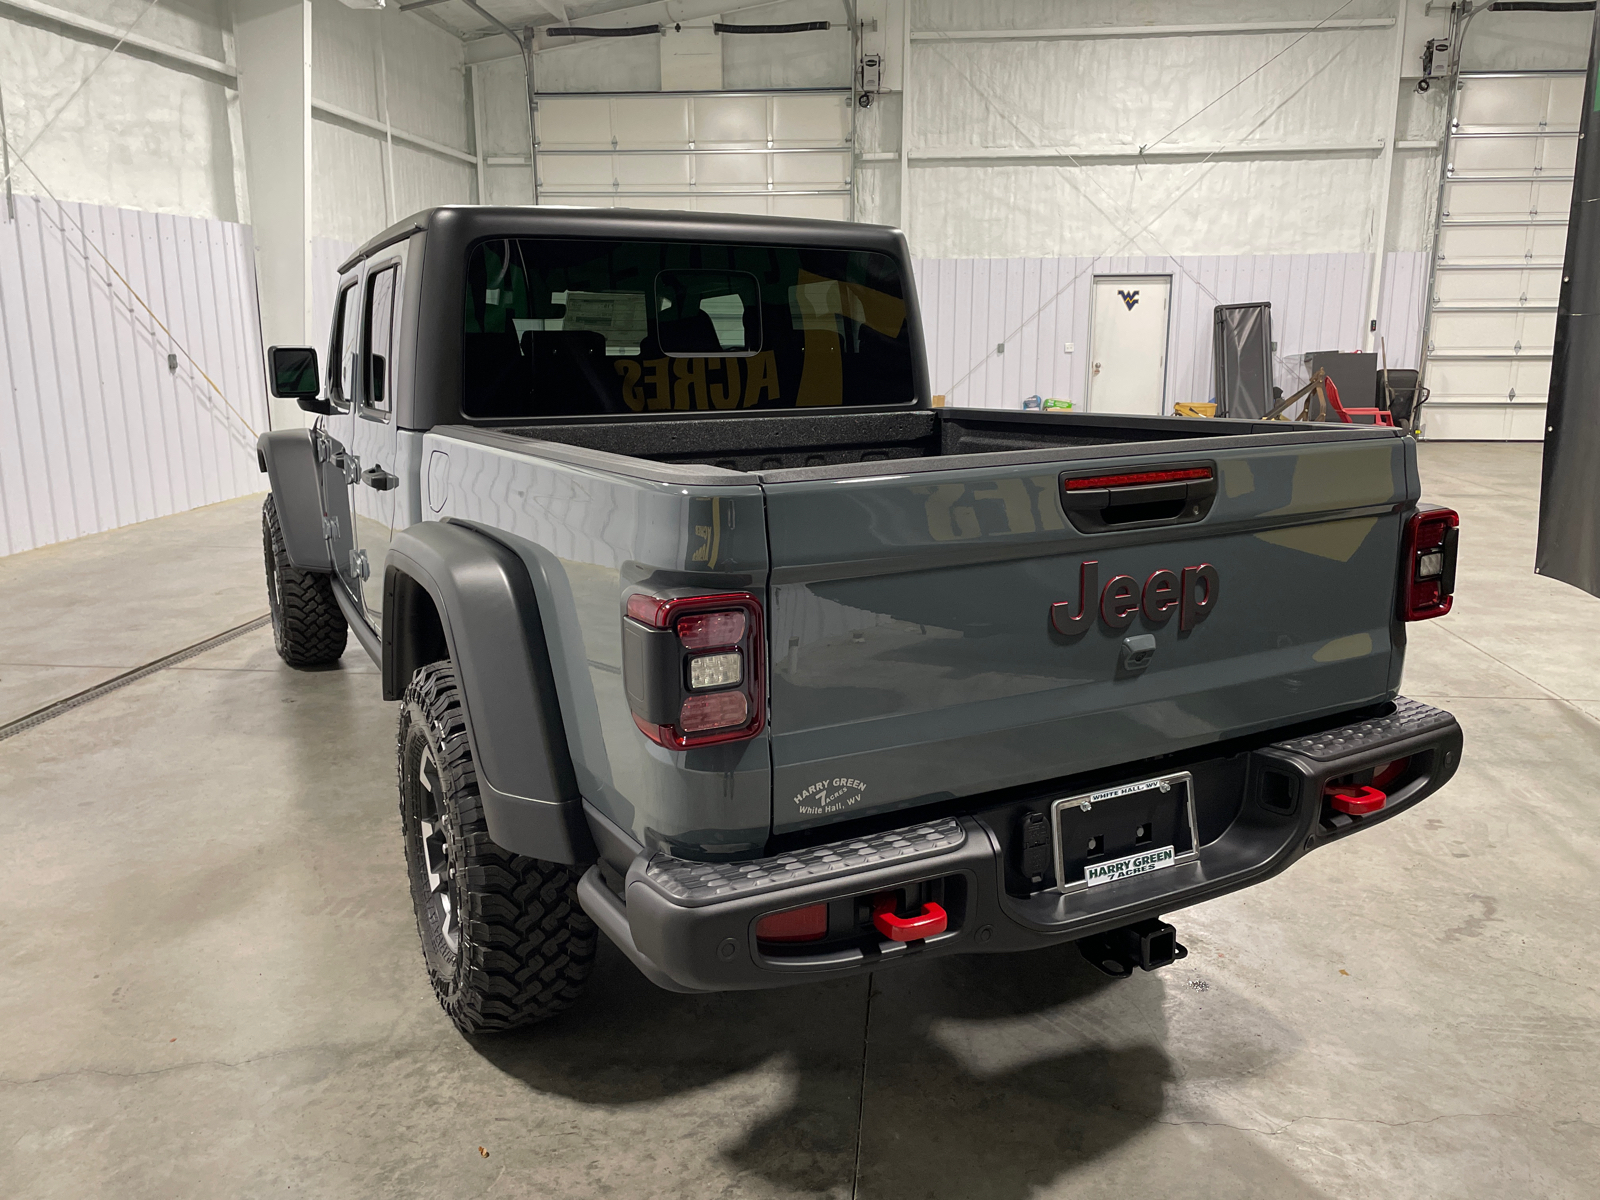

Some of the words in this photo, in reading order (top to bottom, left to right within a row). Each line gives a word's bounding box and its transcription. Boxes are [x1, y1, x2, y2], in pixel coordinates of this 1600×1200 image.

[1051, 560, 1220, 636] Jeep
[793, 779, 830, 804] HARRY
[832, 777, 867, 792] GREEN
[815, 790, 827, 807] 7
[825, 786, 848, 804] ACRES
[1092, 791, 1119, 801] WHITE
[799, 805, 823, 814] White
[825, 802, 845, 813] Hall,
[846, 793, 861, 806] WV
[1088, 860, 1131, 879] HARRY
[1133, 849, 1172, 867] GREEN
[1117, 863, 1156, 878] ACRES
